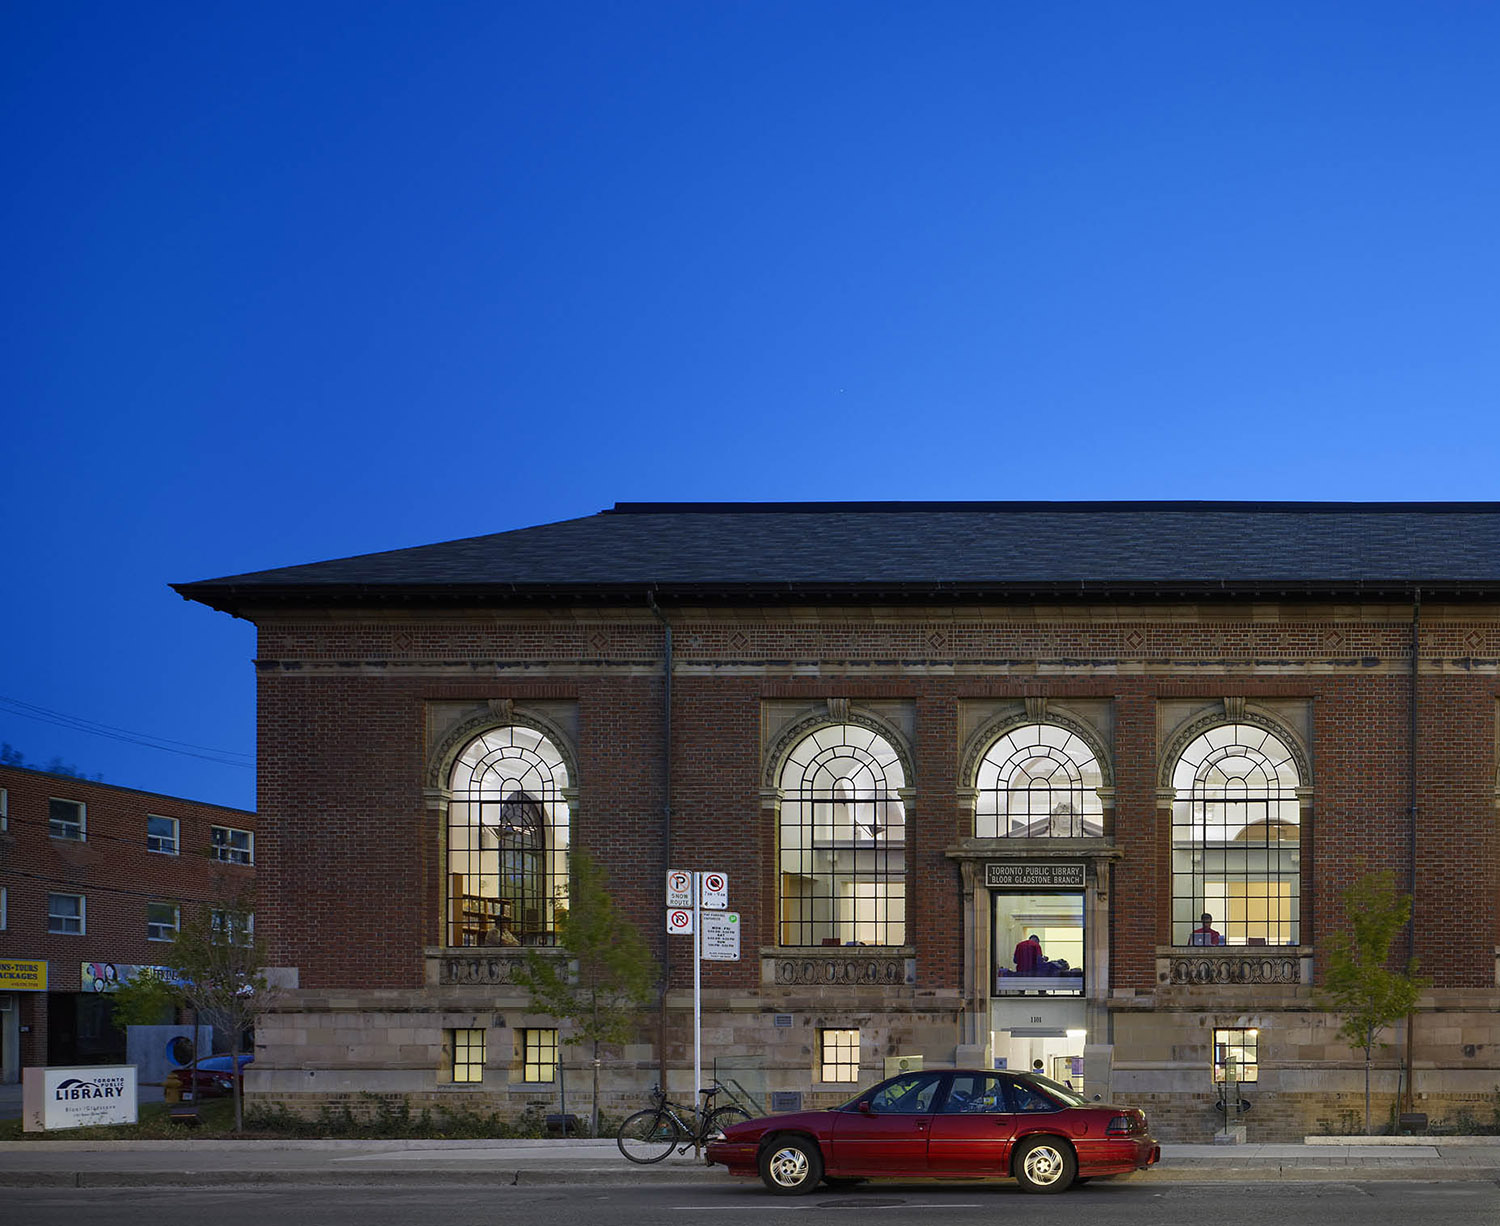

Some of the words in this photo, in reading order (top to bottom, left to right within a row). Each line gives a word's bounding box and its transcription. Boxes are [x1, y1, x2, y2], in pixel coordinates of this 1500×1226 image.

[991, 867, 1023, 875] TORONTO
[1025, 867, 1050, 875] PUBLIC
[1052, 867, 1080, 875] LIBRARY
[56, 1087, 123, 1100] LIBRARY
